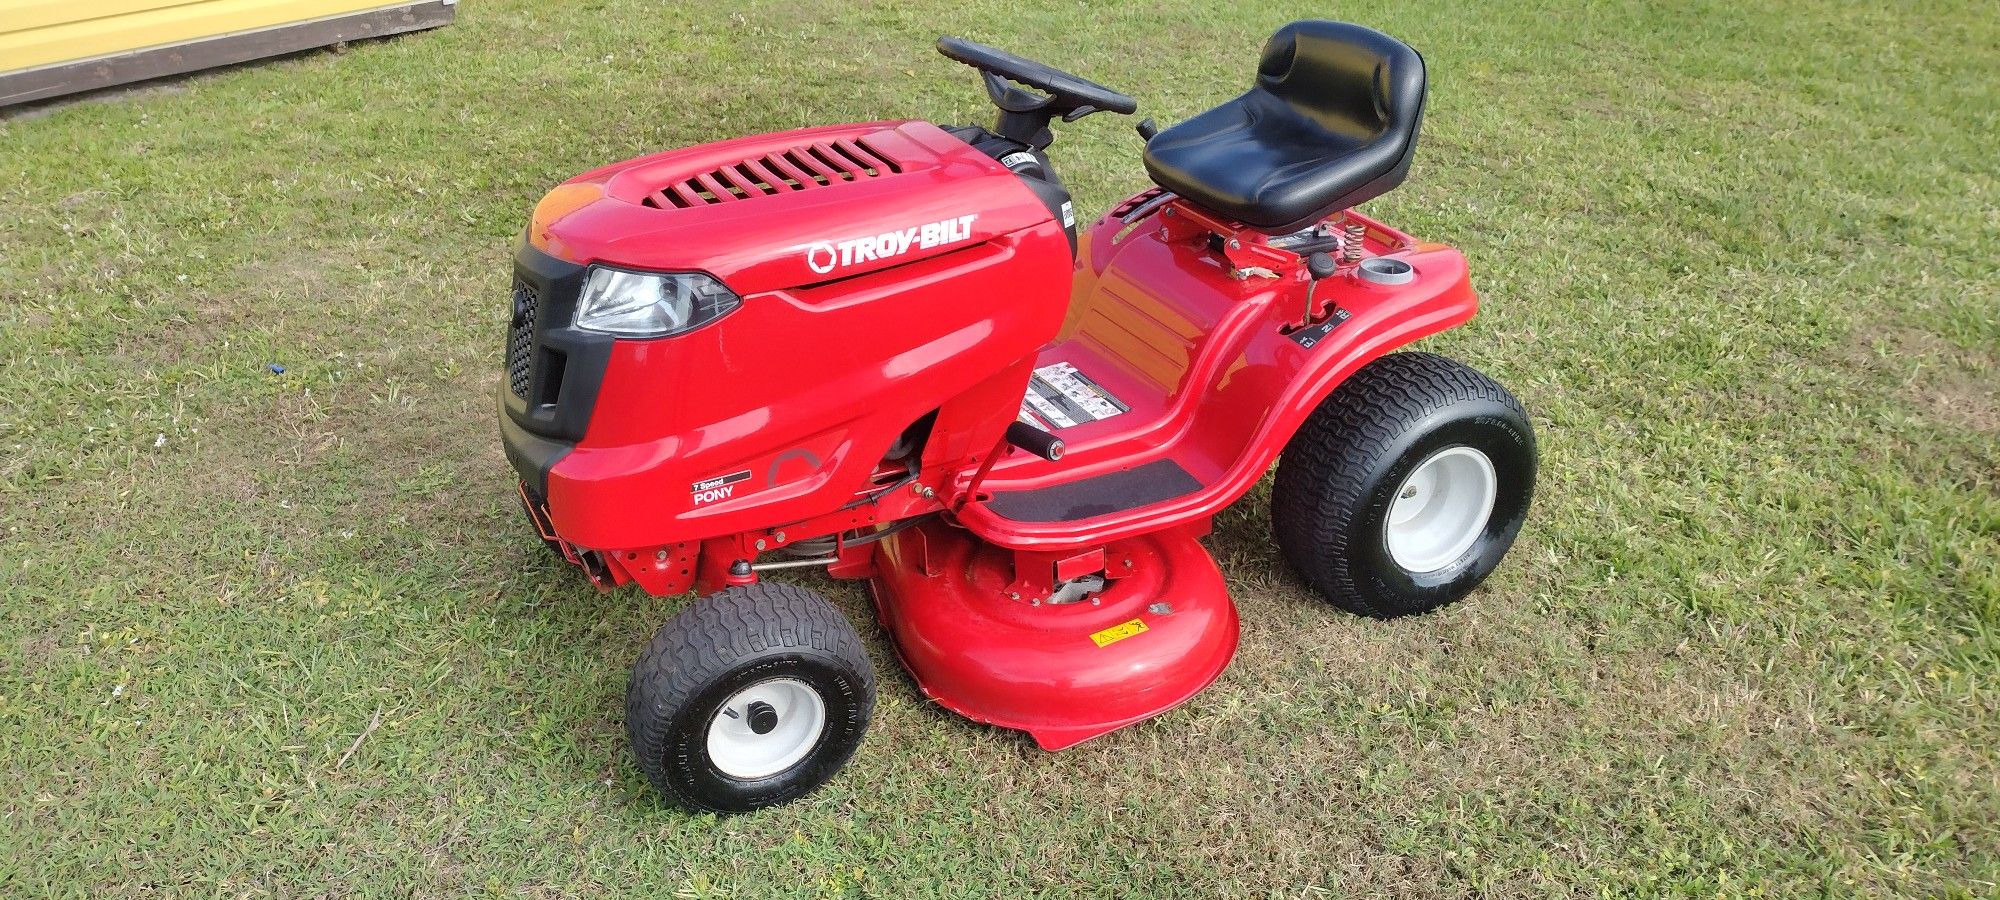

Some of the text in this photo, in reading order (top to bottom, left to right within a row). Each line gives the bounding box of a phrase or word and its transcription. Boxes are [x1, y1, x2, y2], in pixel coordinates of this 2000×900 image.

[838, 214, 975, 266] TROY-BILT
[700, 478, 724, 490] Speed
[693, 485, 734, 505] PONY
